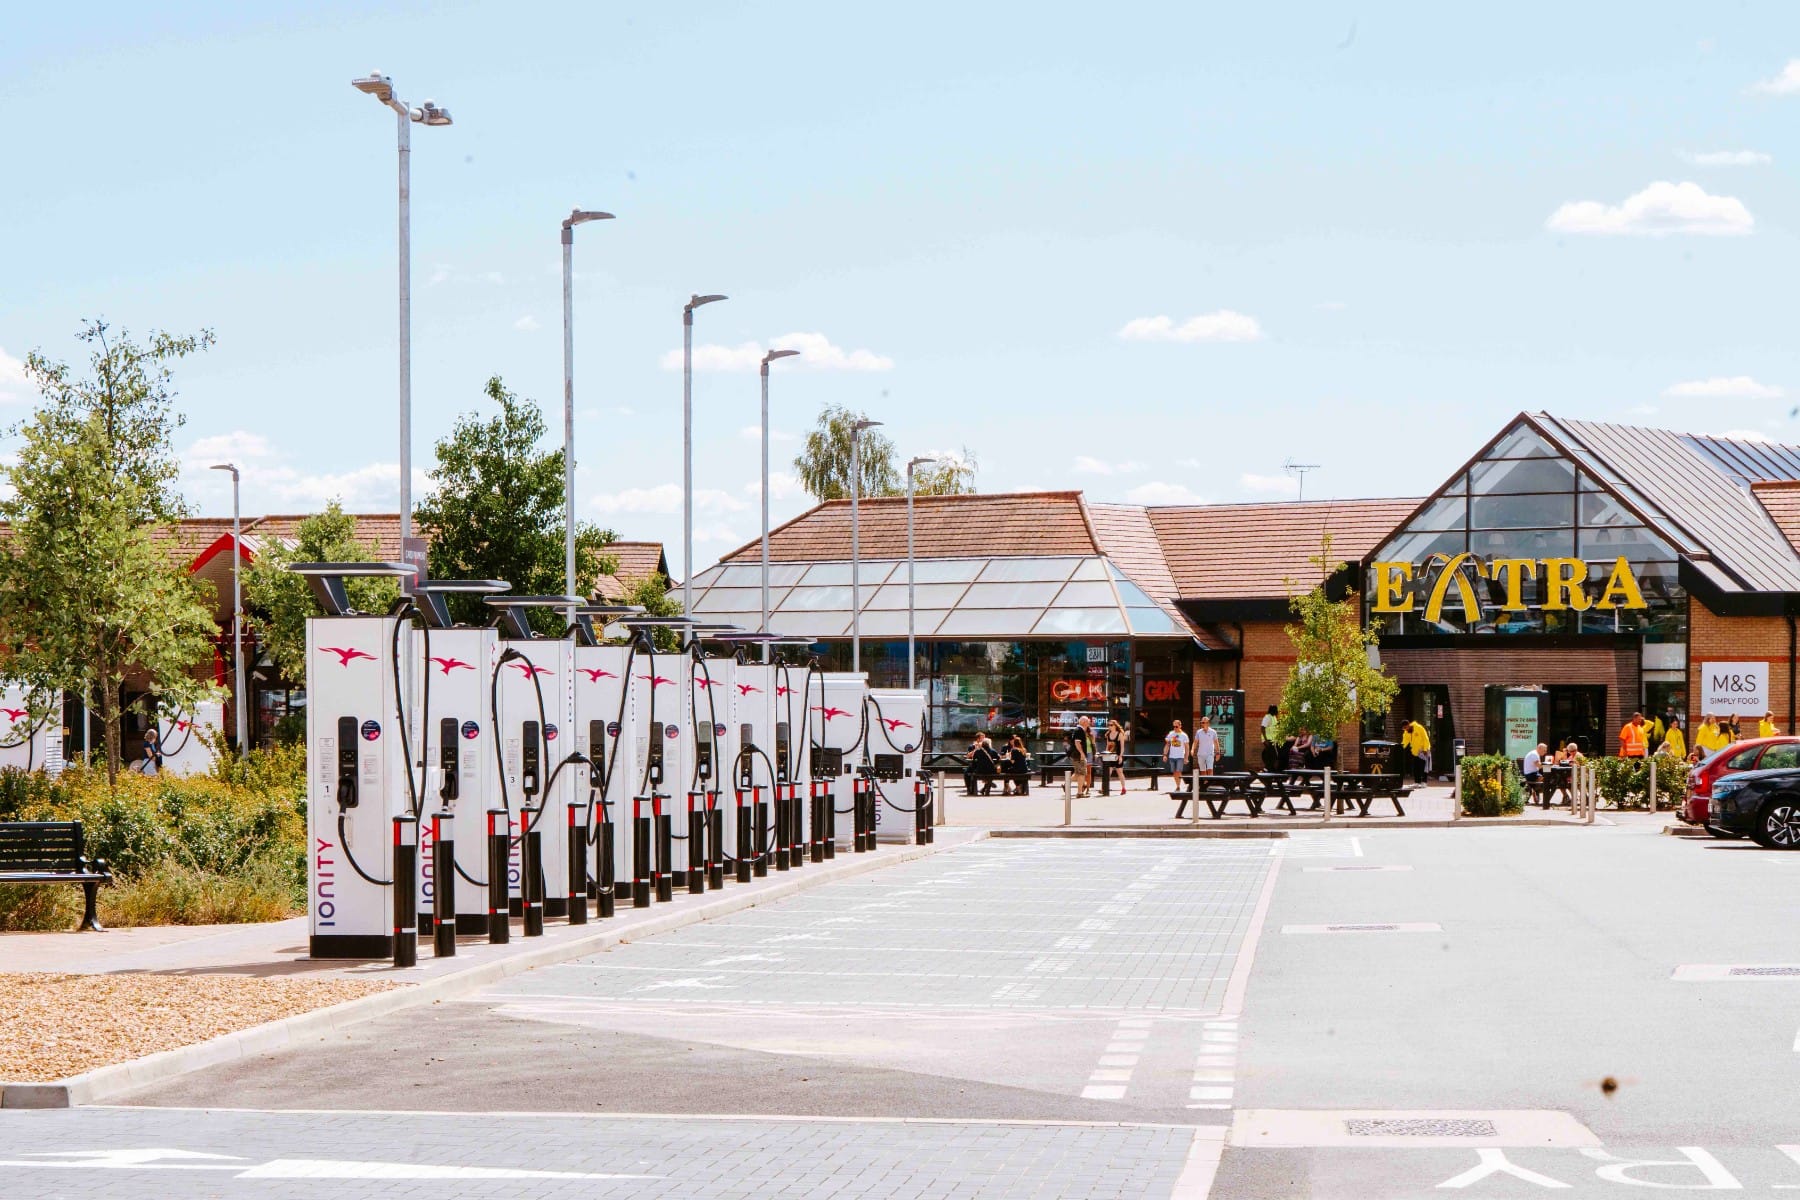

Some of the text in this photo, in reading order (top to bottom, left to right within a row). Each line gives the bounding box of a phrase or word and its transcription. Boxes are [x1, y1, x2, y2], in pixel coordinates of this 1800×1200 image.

[1144, 680, 1180, 702] GDK
[1713, 674, 1756, 693] M&S
[1710, 697, 1759, 705] SIMPLY FOOD
[325, 785, 330, 793] 1
[317, 837, 335, 927] IONITY
